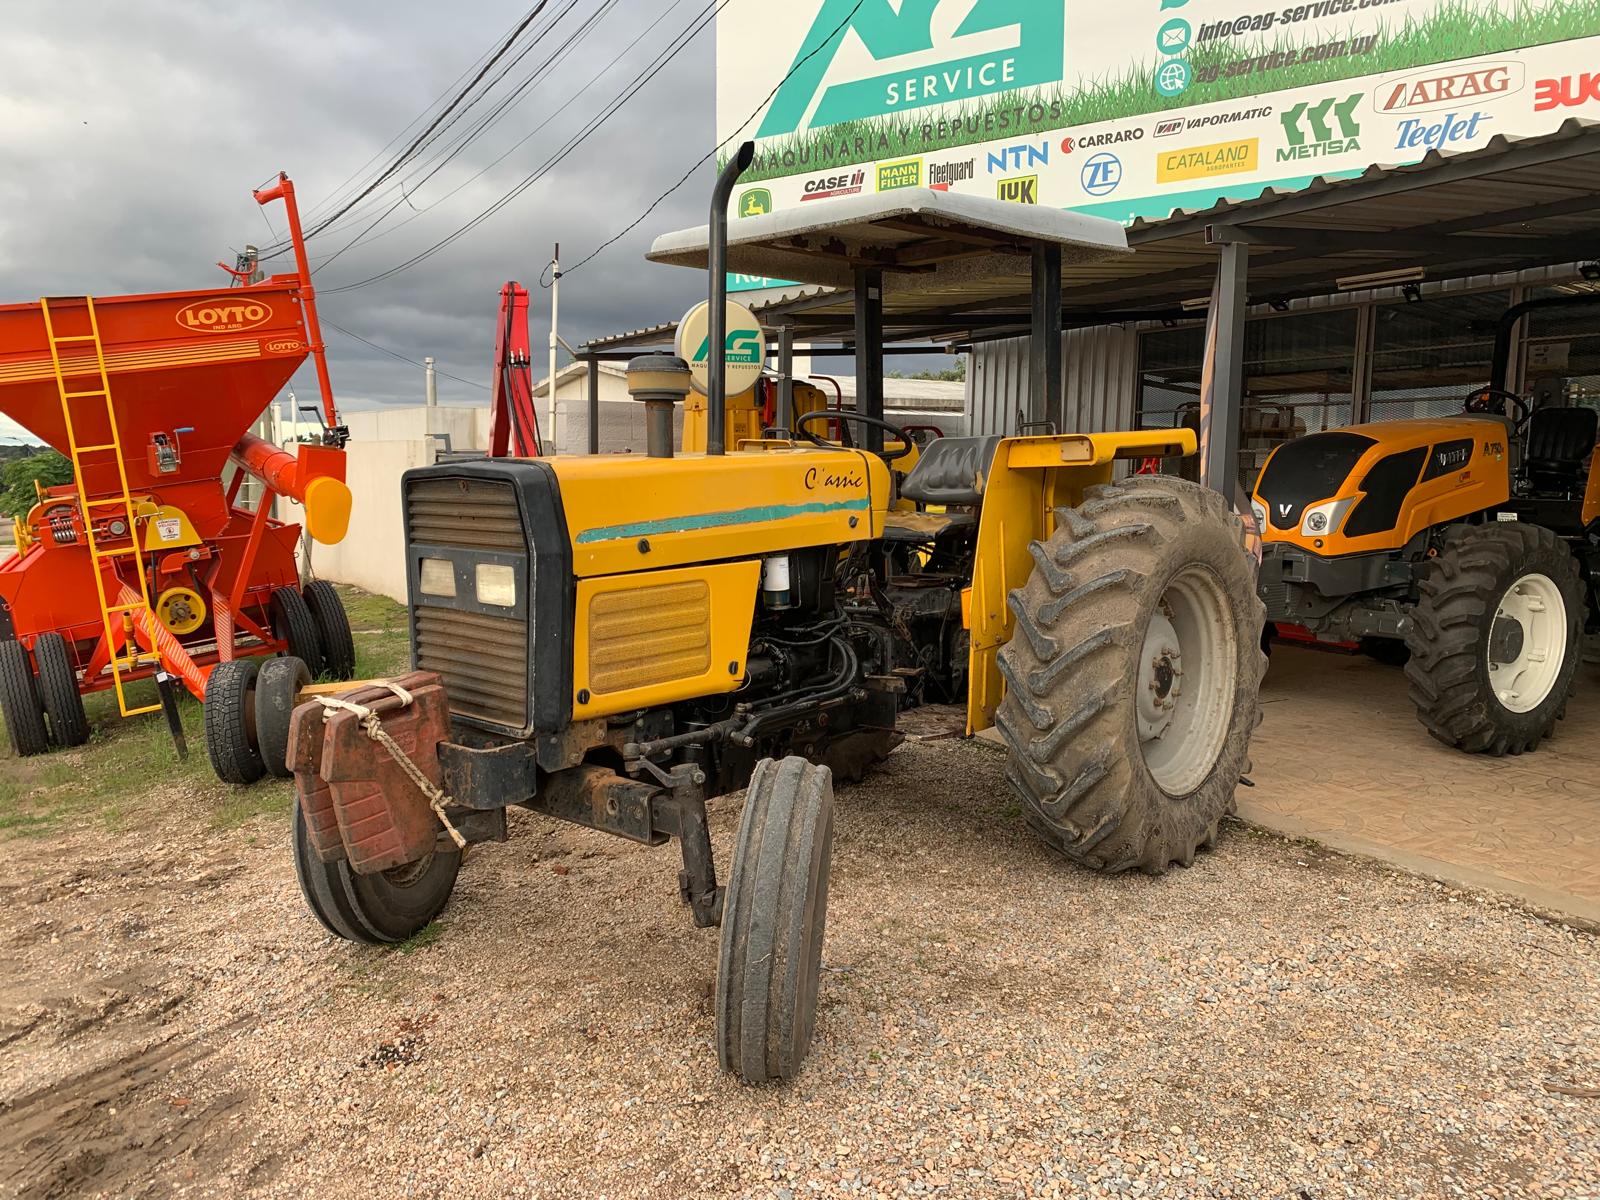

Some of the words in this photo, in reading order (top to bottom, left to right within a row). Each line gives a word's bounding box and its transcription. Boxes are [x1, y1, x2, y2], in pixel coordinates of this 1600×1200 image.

[885, 57, 1015, 106] SERVICE
[1406, 66, 1511, 106] ARAG
[752, 131, 890, 172] MAQUINARIA
[899, 127, 911, 147] Y
[922, 101, 1061, 142] REPUESTOS
[1078, 128, 1144, 149] CARRARO
[1394, 111, 1494, 151] TeeJet
[987, 141, 1049, 174] NTN
[1166, 144, 1249, 171] CATALANO
[1276, 138, 1361, 162] METISA
[804, 175, 849, 193] CASE
[880, 164, 917, 179] MANN
[880, 174, 917, 190] FILTER
[929, 158, 974, 187] Fleetguard
[1085, 160, 1119, 189] ZF
[186, 305, 264, 326] LOYTO
[269, 342, 299, 351] LOYTO
